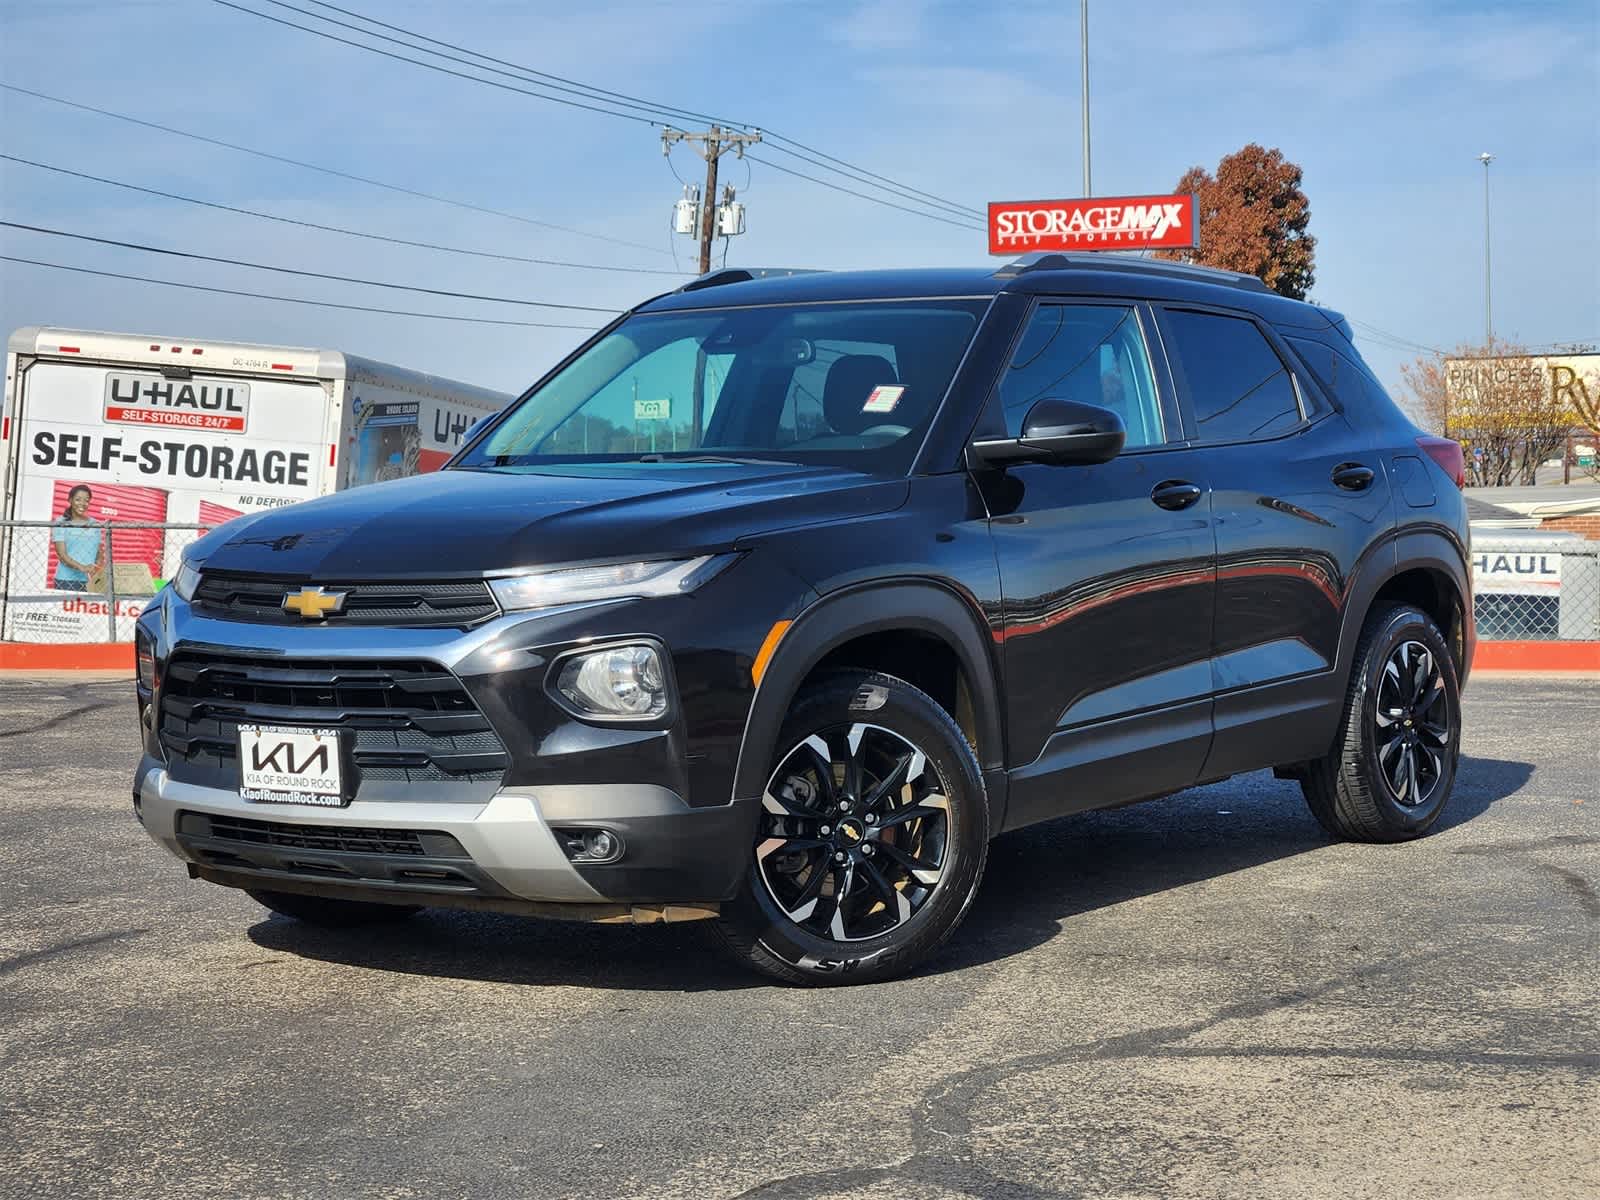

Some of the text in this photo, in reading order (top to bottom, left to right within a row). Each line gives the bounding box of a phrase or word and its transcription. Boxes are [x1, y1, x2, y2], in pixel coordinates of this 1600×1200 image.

[998, 231, 1148, 245] SELF STORAGE
[1450, 367, 1543, 385] PRINCESS
[122, 410, 229, 428] SELF-STORAGE 24/7
[32, 431, 309, 486] SELF-STORAGE
[239, 496, 253, 504] NO
[26, 612, 49, 622] FREE
[252, 741, 328, 775] KIA
[246, 774, 337, 789] KIA OF ROUND ROCK
[240, 787, 340, 805] KiaofRoundRock.com
